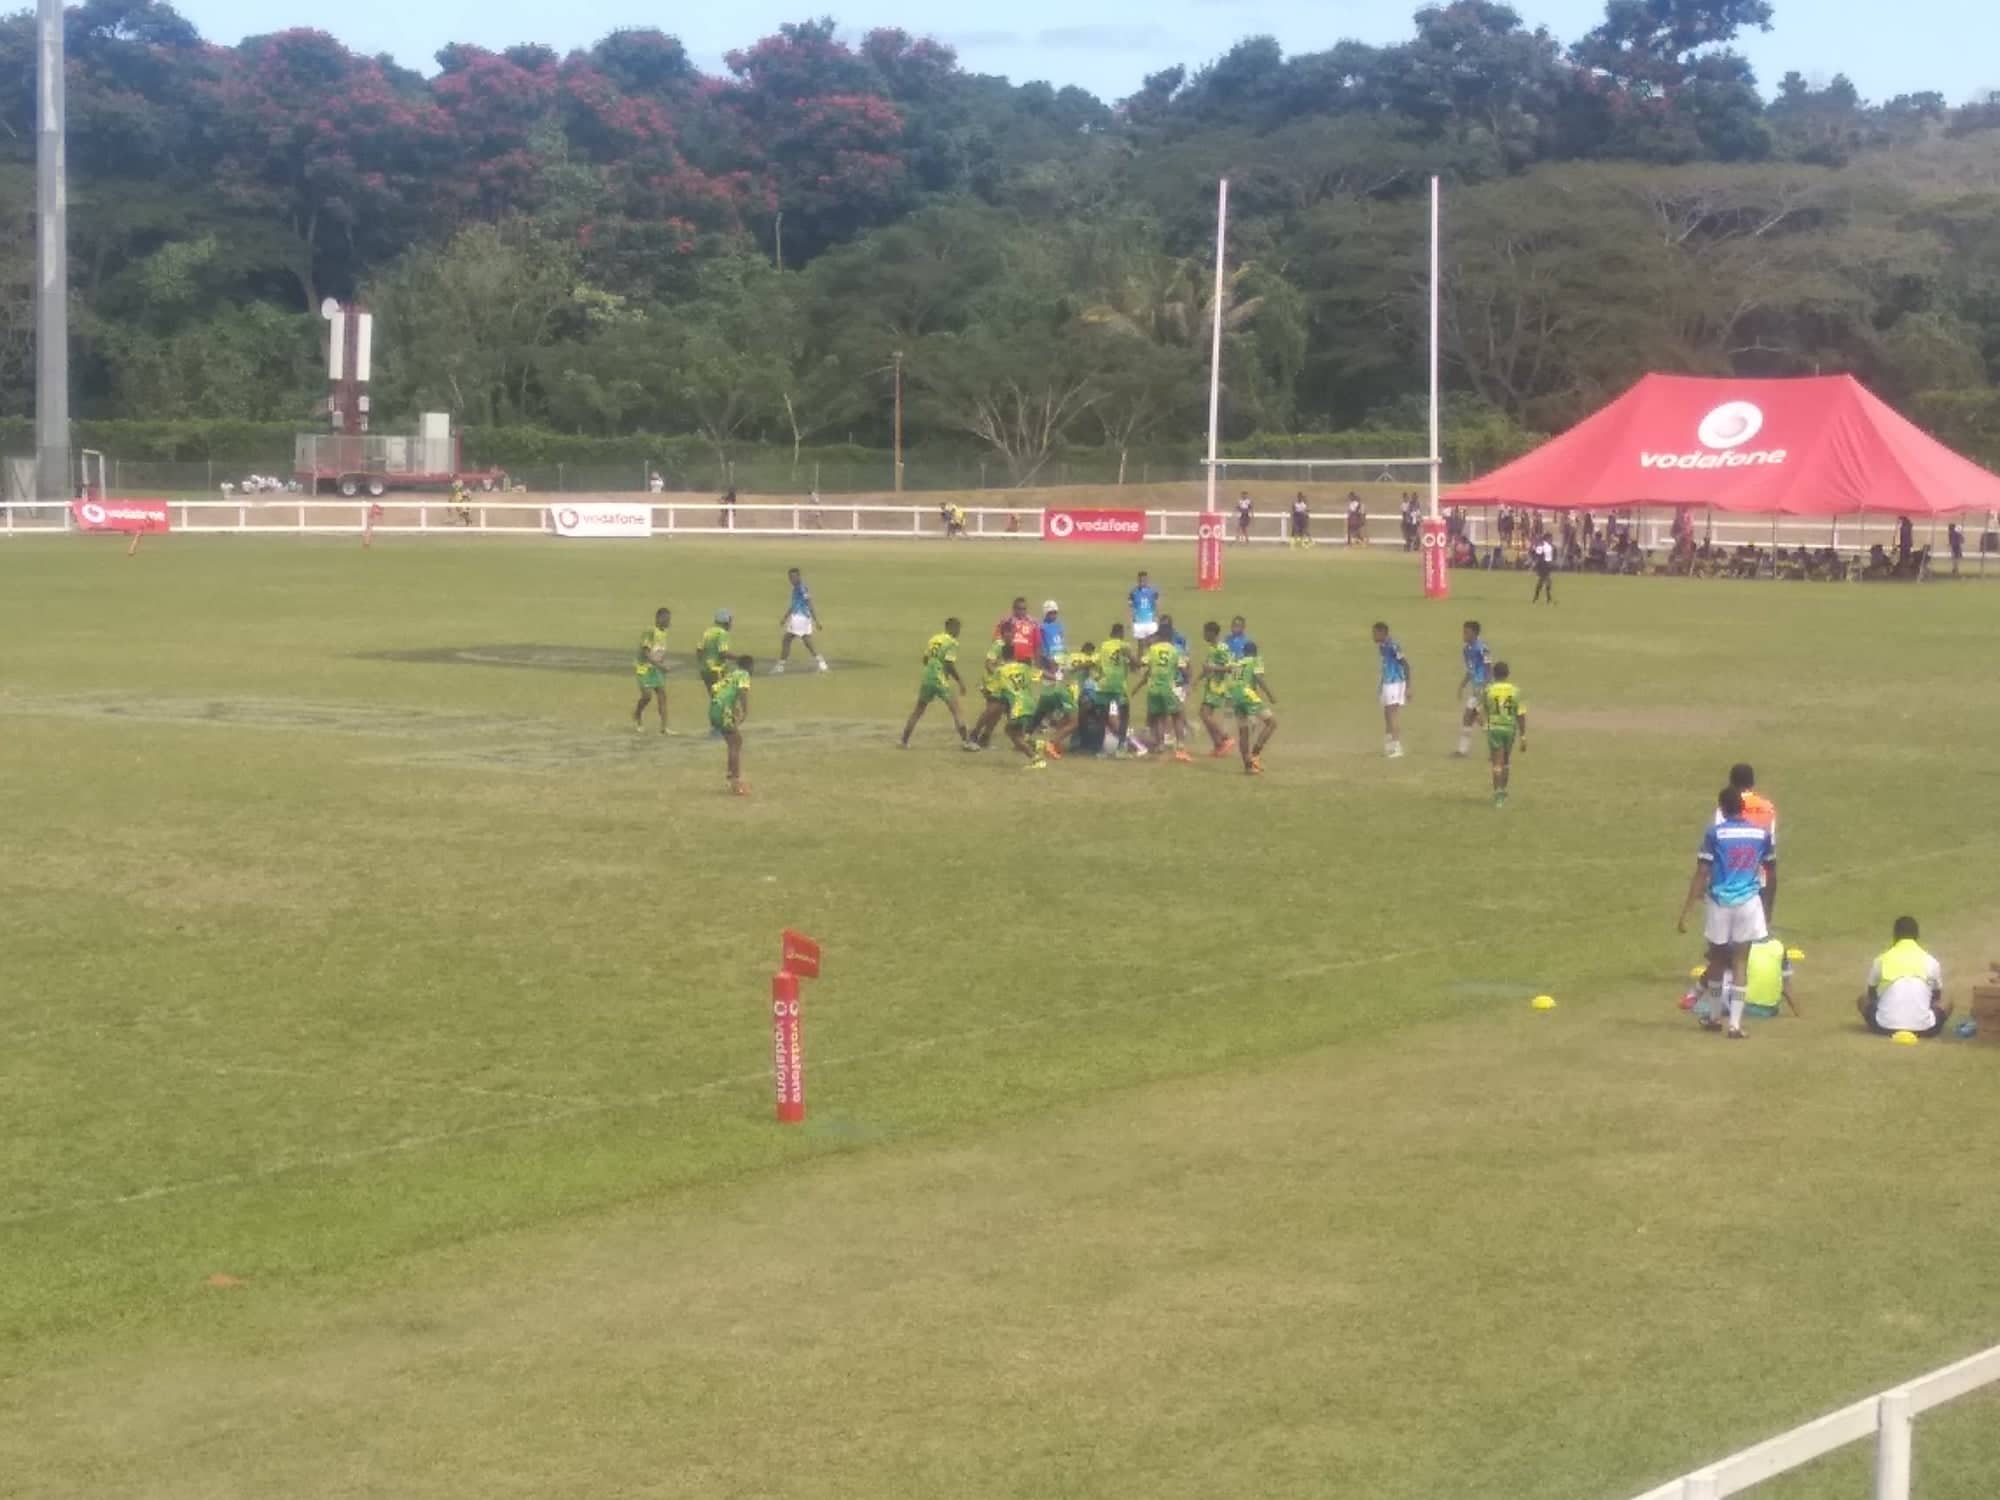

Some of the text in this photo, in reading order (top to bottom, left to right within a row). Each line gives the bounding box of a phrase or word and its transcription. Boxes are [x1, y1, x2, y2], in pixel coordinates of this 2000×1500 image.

[1640, 449, 1787, 469] vodafone
[582, 511, 646, 526] vodafone
[1075, 517, 1140, 533] vodafone
[1494, 695, 1513, 716] 14
